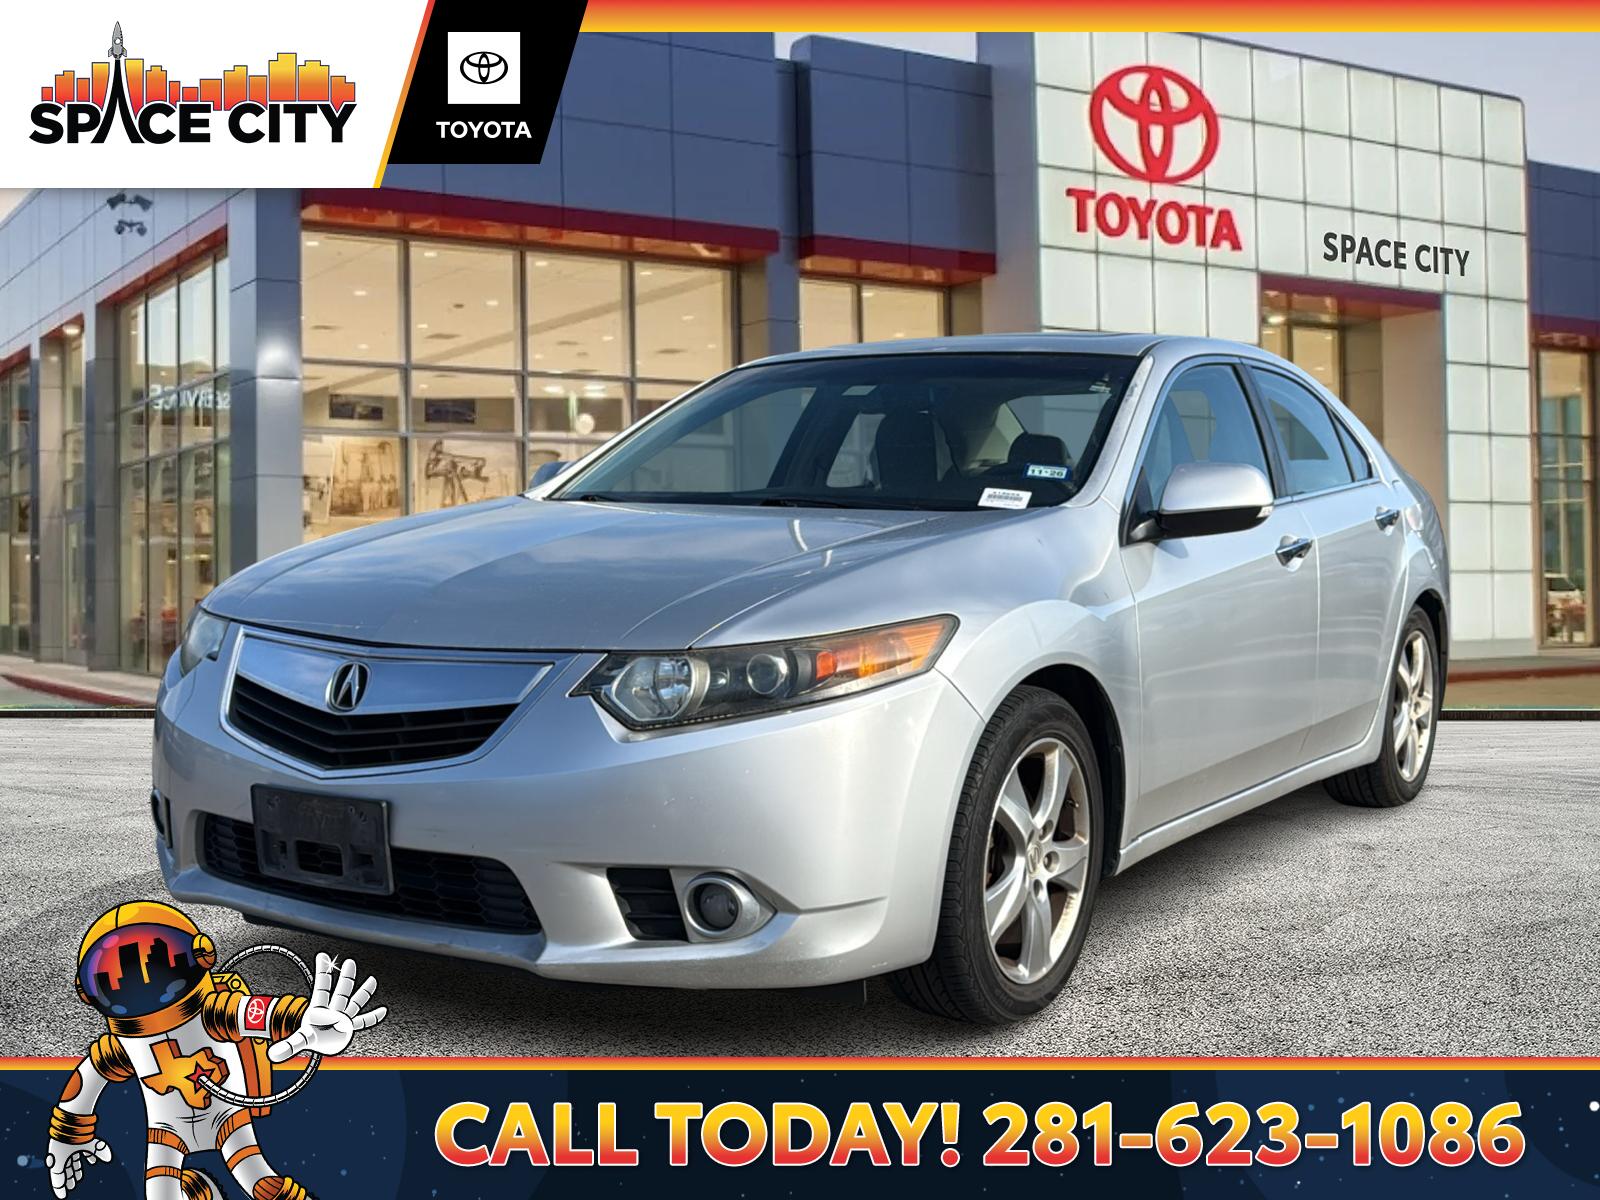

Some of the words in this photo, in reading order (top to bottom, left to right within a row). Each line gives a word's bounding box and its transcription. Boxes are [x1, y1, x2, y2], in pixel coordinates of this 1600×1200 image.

[1066, 187, 1243, 251] TOYOTA
[1323, 231, 1407, 270] SPACE
[1415, 244, 1471, 277] CITY
